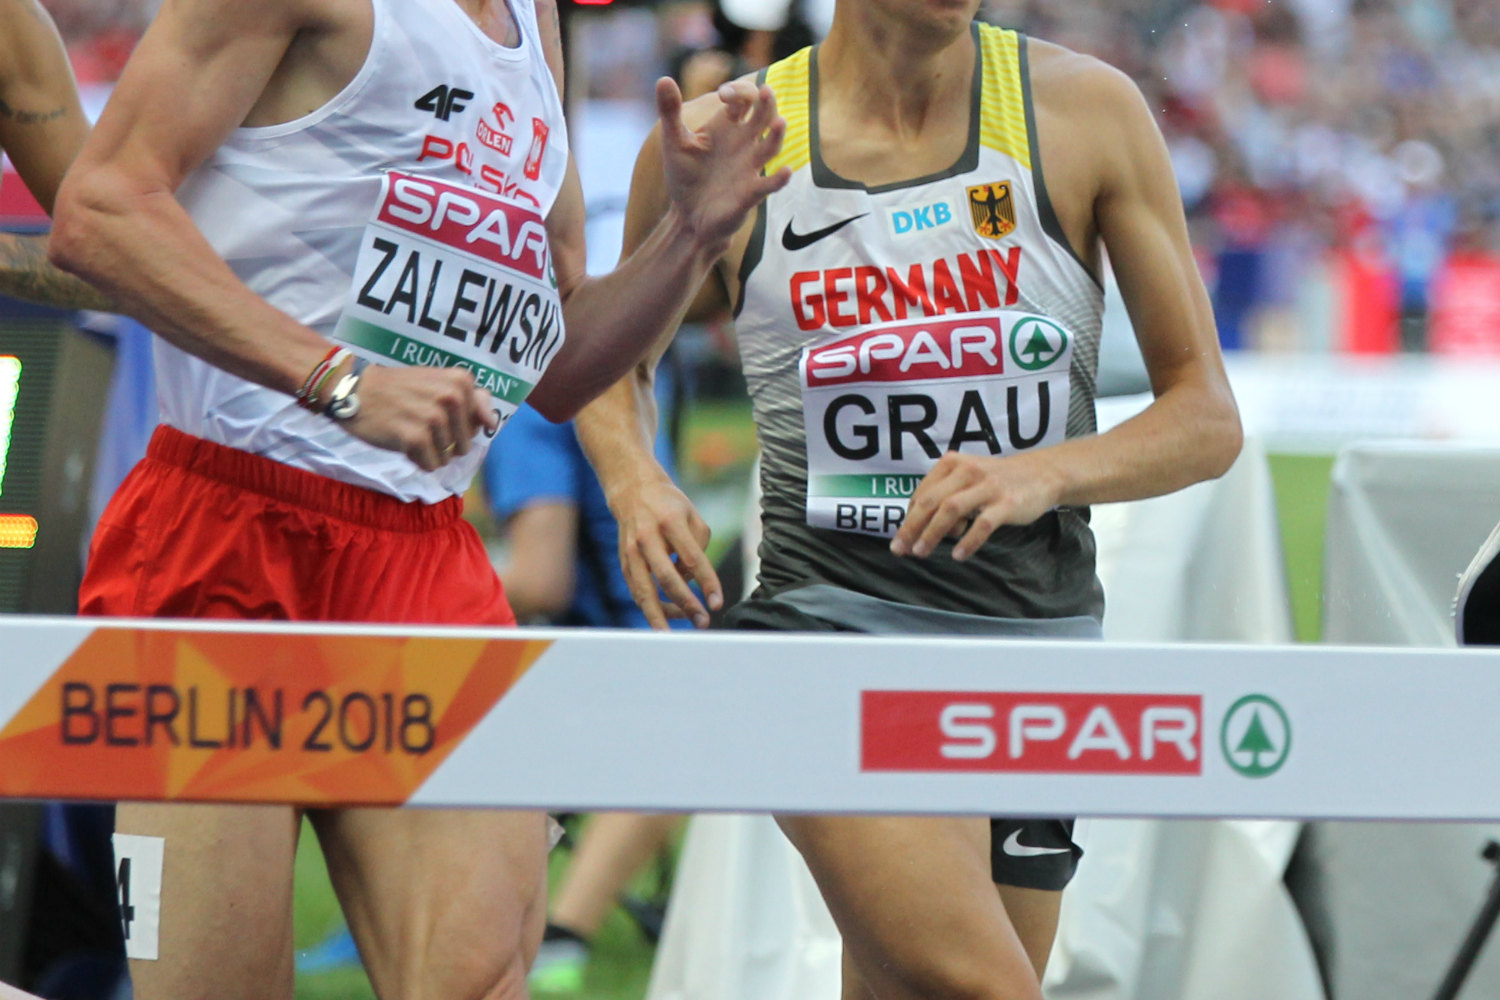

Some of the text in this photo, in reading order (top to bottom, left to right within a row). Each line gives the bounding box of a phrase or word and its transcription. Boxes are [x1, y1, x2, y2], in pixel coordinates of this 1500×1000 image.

[414, 84, 475, 122] 4F
[477, 121, 512, 154] ORLEN
[387, 178, 547, 270] SPAR
[892, 202, 951, 235] DKB
[356, 237, 561, 372] ZALEWSKI
[790, 246, 1021, 331] GERMANY
[390, 337, 401, 356] I
[402, 342, 450, 368] RUN
[812, 325, 998, 378] SPAR
[823, 380, 1050, 461] GRAU
[885, 477, 922, 496] RU
[836, 503, 906, 533] BER
[61, 682, 437, 756] BERLIN 2018
[939, 703, 1199, 761] SPAR
